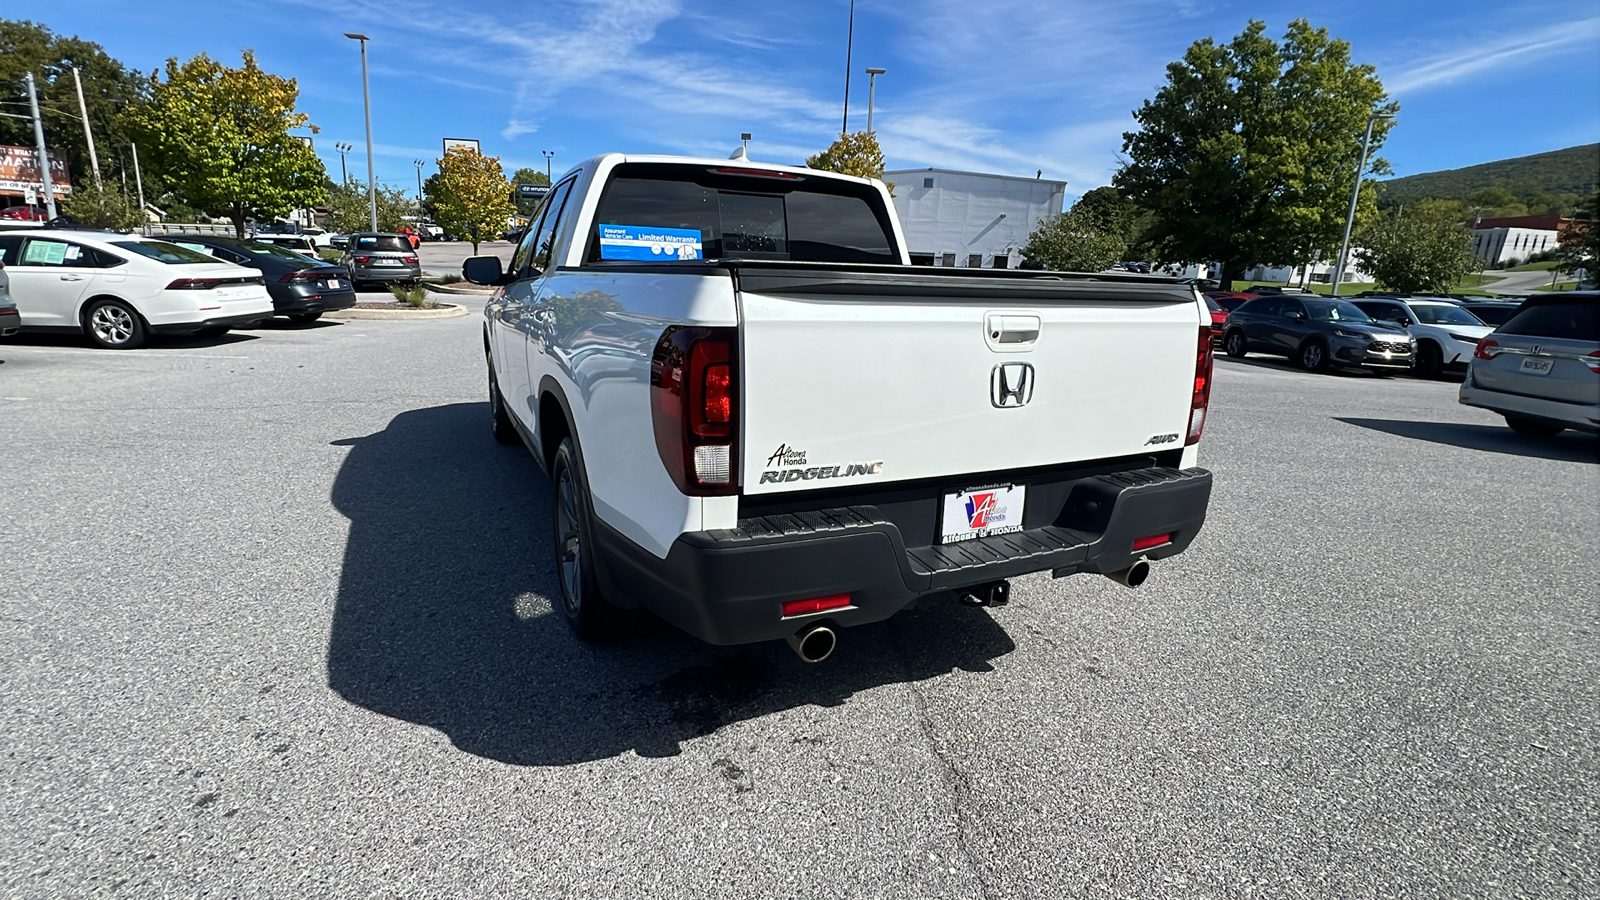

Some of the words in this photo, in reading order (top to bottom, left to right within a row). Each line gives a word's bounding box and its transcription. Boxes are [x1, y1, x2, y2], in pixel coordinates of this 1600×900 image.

[14, 148, 33, 156] WHAT
[638, 233, 665, 242] Limited
[665, 235, 698, 244] Warranty
[1144, 433, 1179, 446] AWD
[767, 443, 807, 467] Altoona
[783, 458, 807, 466] Honda
[759, 461, 884, 484] RIDGELINE
[941, 532, 977, 545] Altoona
[990, 525, 1024, 536] HONDA
